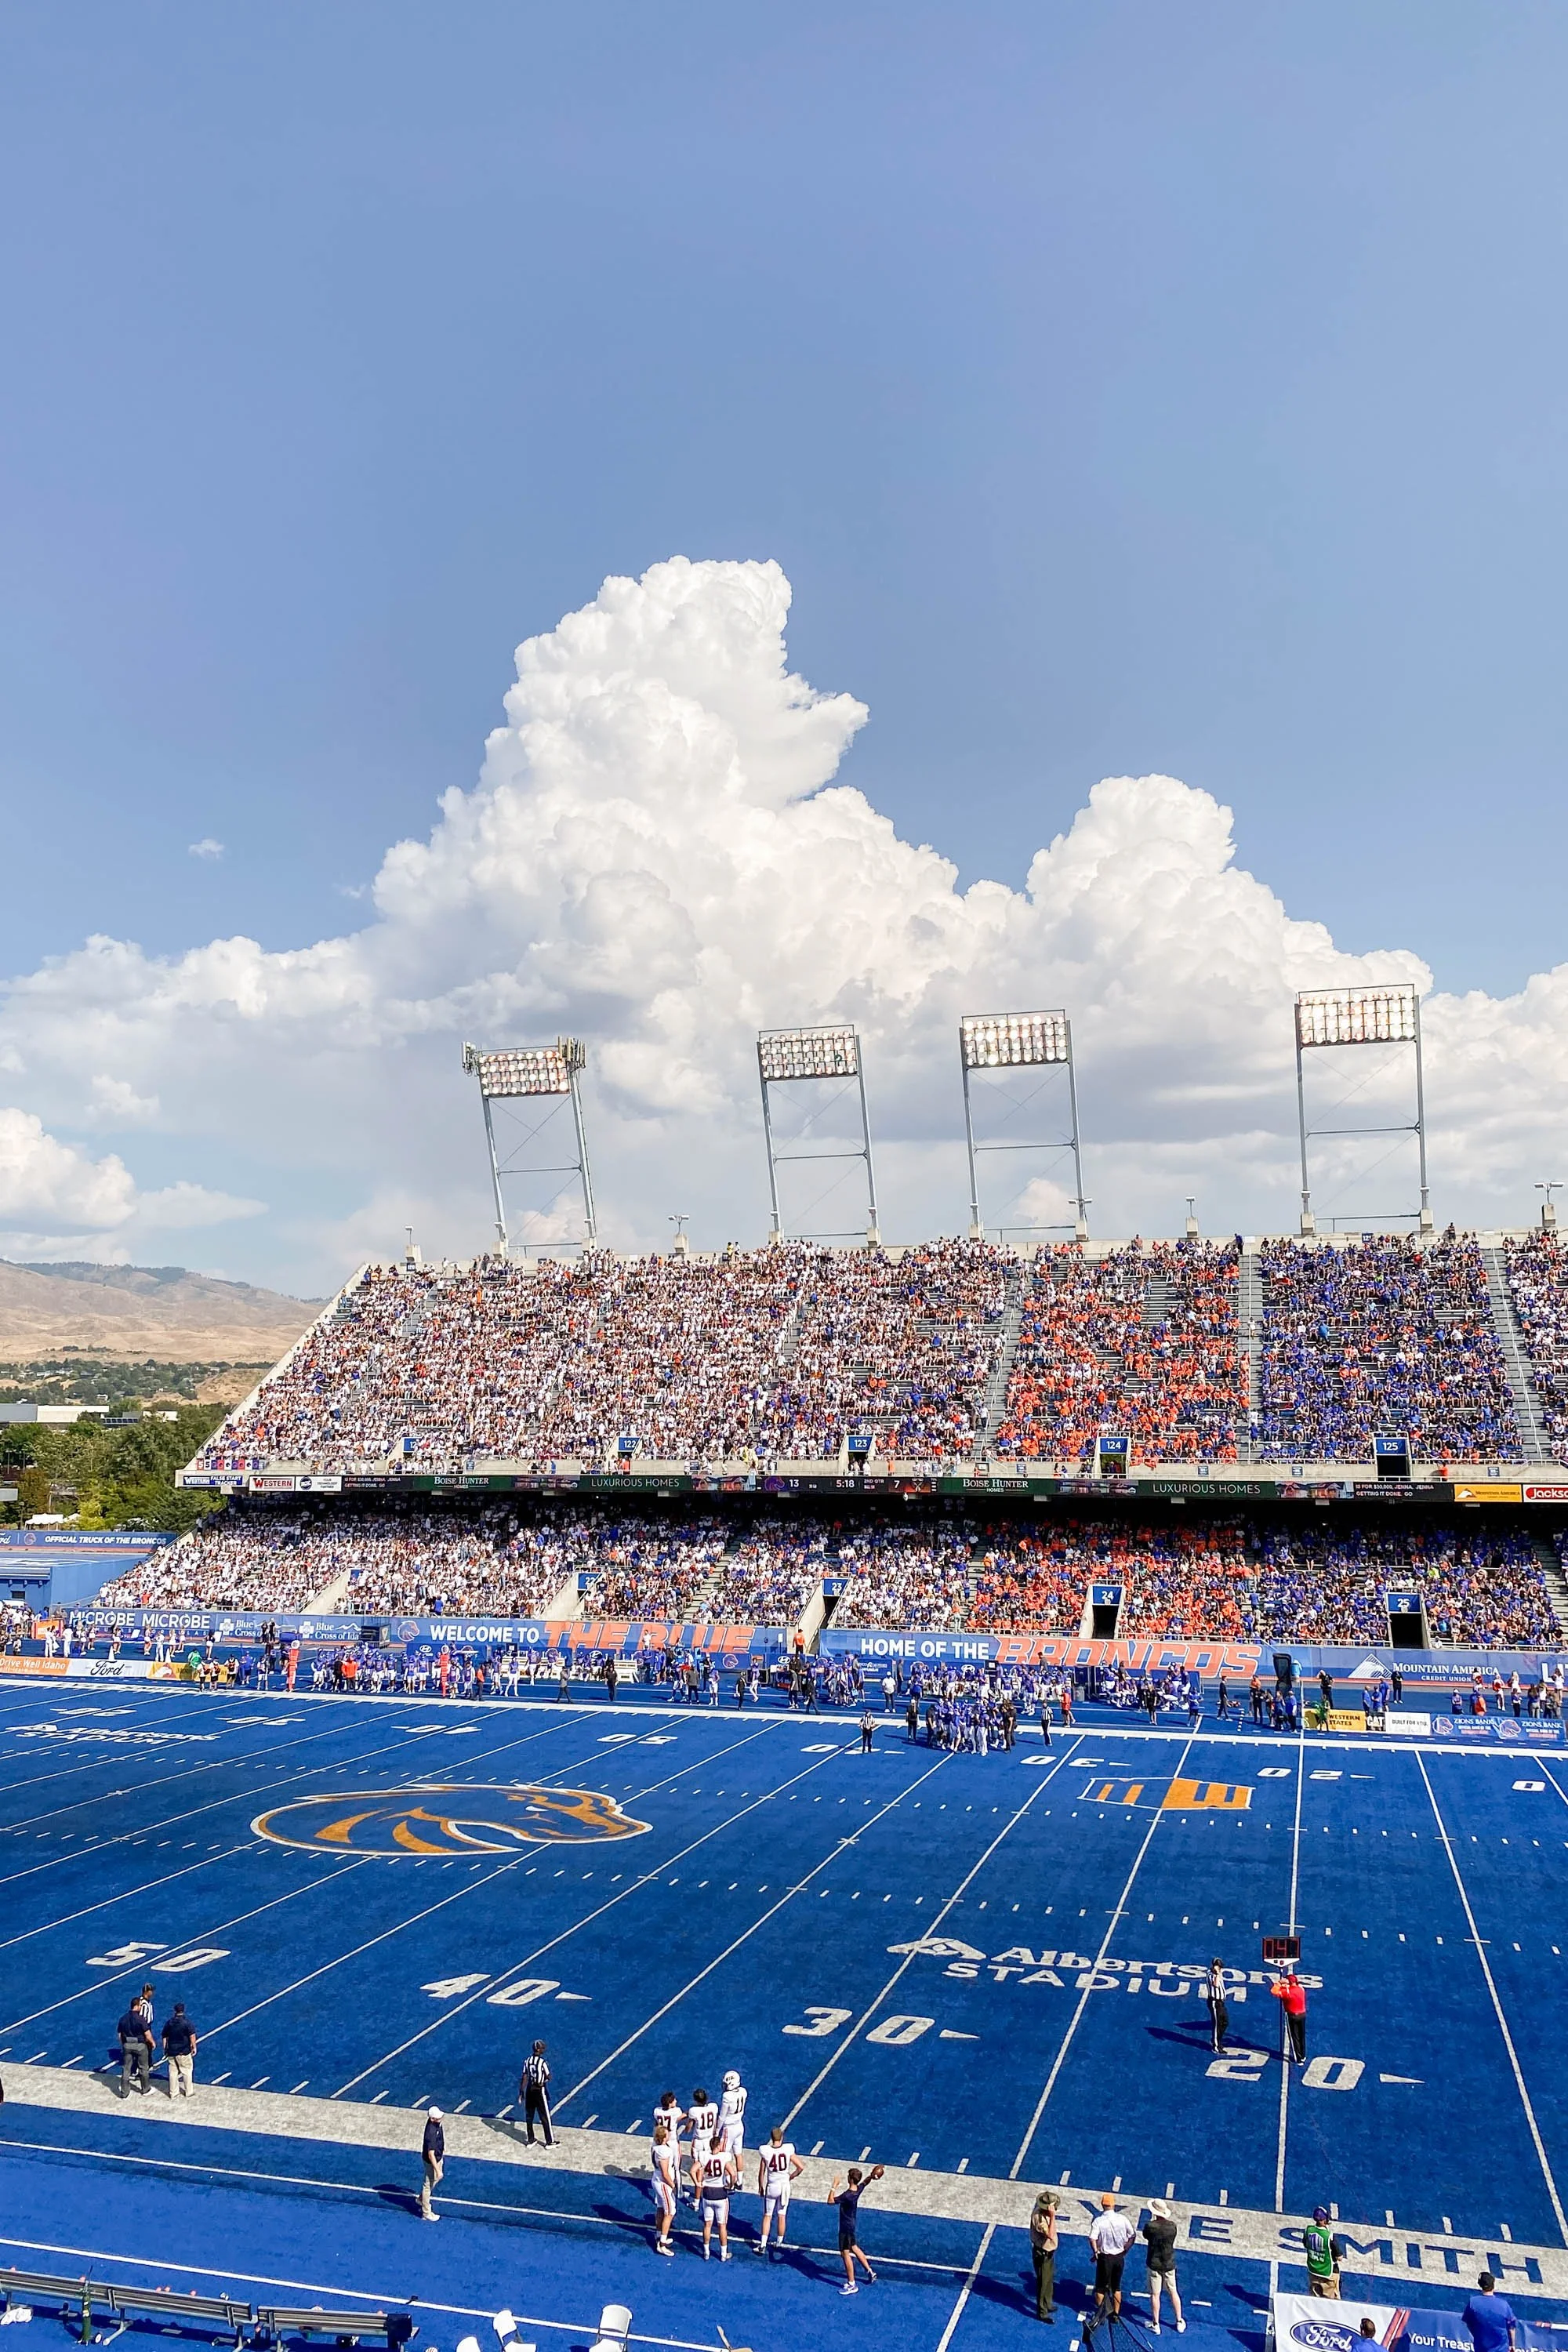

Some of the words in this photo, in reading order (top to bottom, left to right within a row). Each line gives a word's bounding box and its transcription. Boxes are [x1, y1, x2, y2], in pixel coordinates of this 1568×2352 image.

[623, 1439, 636, 1448] 122
[1106, 1441, 1121, 1450] 124
[1382, 1442, 1399, 1450] 125
[252, 1477, 292, 1489] WESTERN
[434, 1476, 457, 1485] BOISE
[459, 1476, 489, 1485] HUNTER
[591, 1479, 643, 1487] LUXURIOUS
[645, 1479, 680, 1487] HOMES
[836, 1479, 855, 1488] 5:18
[963, 1479, 989, 1487] BOISE
[992, 1479, 1029, 1488] HUNTER
[1152, 1483, 1215, 1494] LUXURIOUS
[1219, 1484, 1261, 1494] HOMES
[585, 1577, 596, 1585] 22
[832, 1582, 842, 1592] 23
[1102, 1591, 1113, 1601] 24
[1397, 1598, 1410, 1608] 25
[142, 1613, 211, 1629] MICROBE
[236, 1619, 254, 1628] Blue
[316, 1622, 335, 1631] Blue
[235, 1628, 256, 1637] Cross
[315, 1631, 337, 1640] Cross
[338, 1632, 346, 1640] of
[430, 1624, 513, 1642] WELCOME
[517, 1627, 539, 1644] TO
[543, 1621, 630, 1652] THE
[24, 1659, 41, 1668] Well
[42, 1661, 66, 1669] Idaho
[862, 1639, 916, 1657] HOME
[921, 1640, 947, 1658] OF
[952, 1642, 989, 1660] THE
[996, 1636, 1263, 1681] BRONCOS
[90, 1660, 125, 1675] Ford
[1392, 1662, 1450, 1674] MOUNTAIN
[1367, 1715, 1385, 1727] CAT
[16, 1731, 169, 1745] STADIUM
[85, 1941, 231, 1973] 50
[990, 1947, 1323, 1989] Albertsons
[942, 1962, 1248, 2003] STADIUM
[420, 1973, 561, 2006] 40
[782, 2006, 935, 2044] 30
[1204, 2047, 1366, 2091] 20
[699, 2111, 714, 2130] 18
[705, 2158, 723, 2177] 48
[768, 2153, 787, 2172] 40
[1278, 2227, 1544, 2285] SMITH
[1305, 2324, 1352, 2350] Ford
[1410, 2332, 1436, 2347] Your
